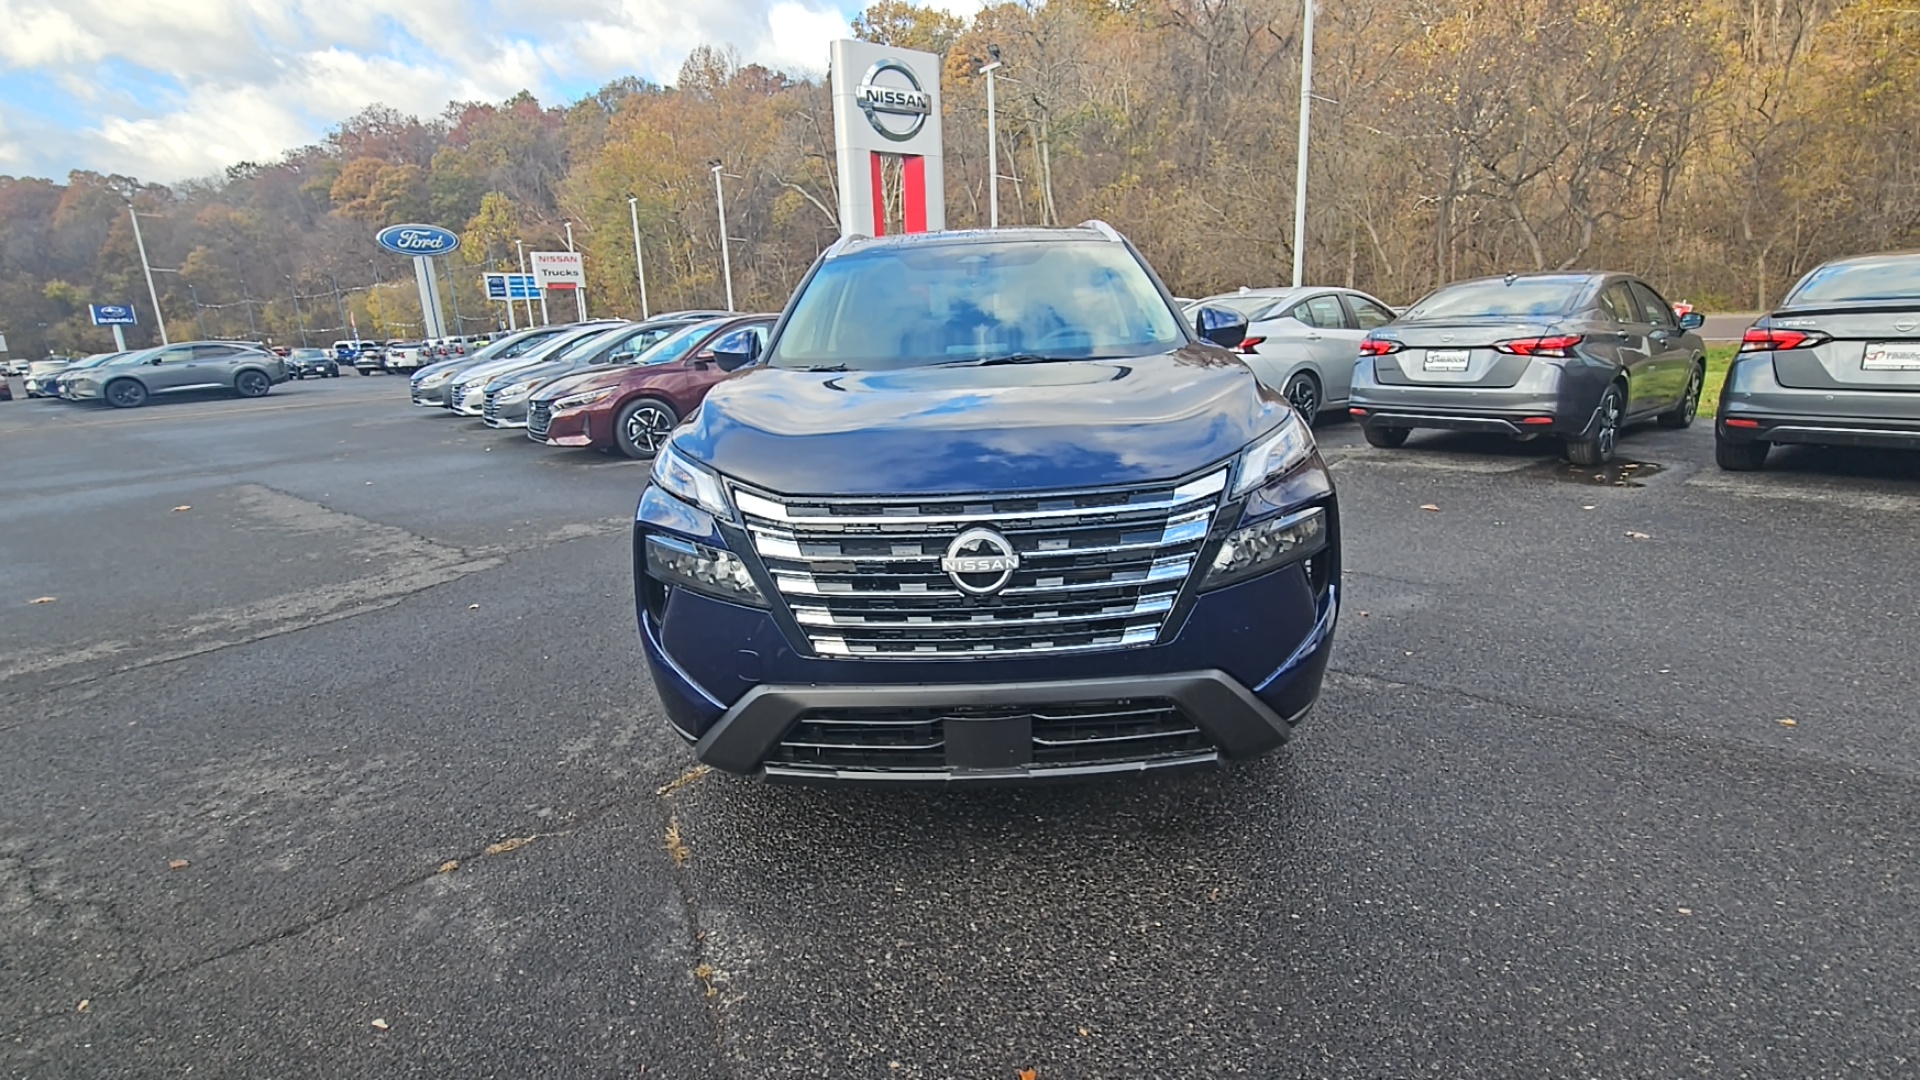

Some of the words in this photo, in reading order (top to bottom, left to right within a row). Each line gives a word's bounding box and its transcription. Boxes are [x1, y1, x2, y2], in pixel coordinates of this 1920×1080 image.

[866, 89, 927, 109] NISSAN
[397, 230, 443, 249] Ford
[538, 255, 577, 263] NISSAN
[541, 269, 579, 277] Trucks
[944, 558, 1018, 571] NISSAN
